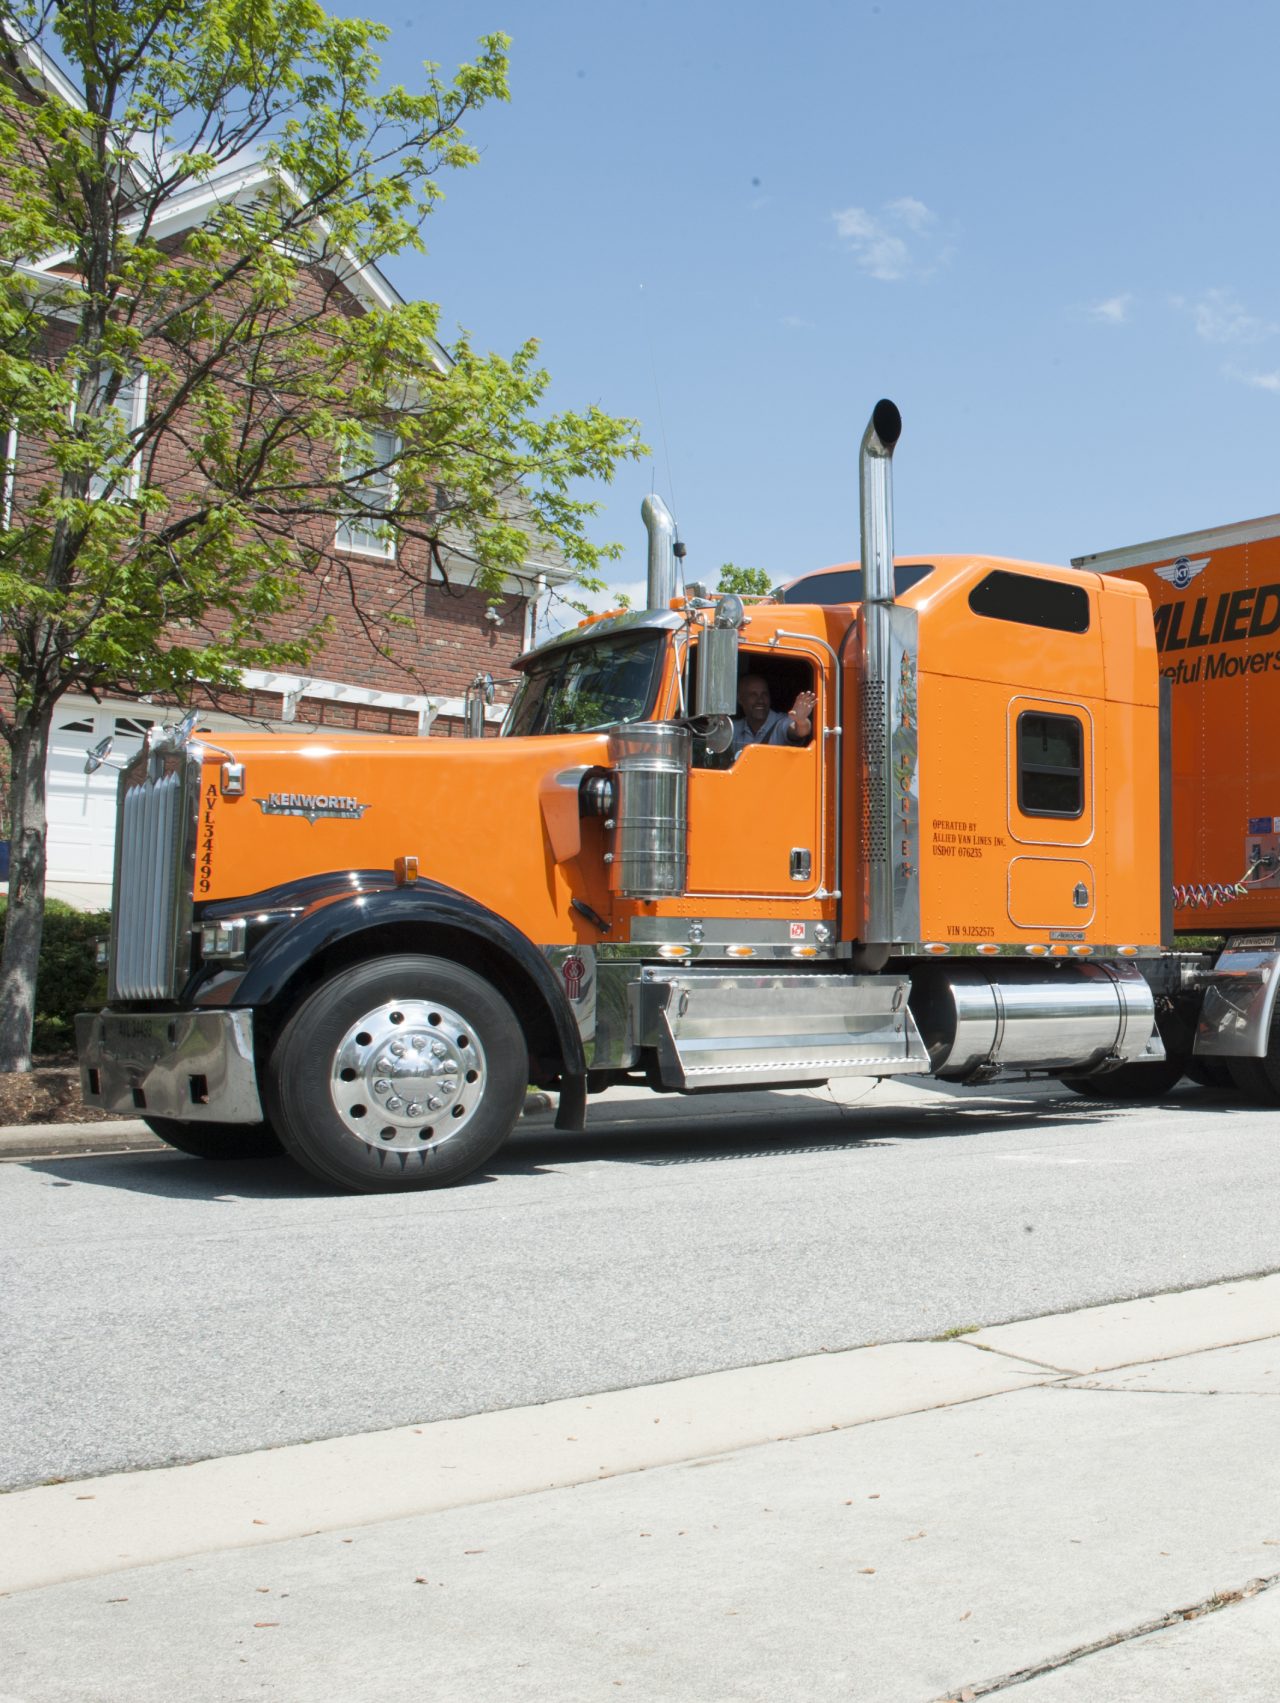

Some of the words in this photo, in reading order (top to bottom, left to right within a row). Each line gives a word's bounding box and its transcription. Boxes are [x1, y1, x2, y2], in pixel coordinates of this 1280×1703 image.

[270, 793, 357, 809] KENWORTH
[933, 820, 967, 831] OPERATED
[199, 784, 217, 893] AVL34499
[933, 832, 956, 843] ALLIED
[957, 834, 971, 844] VAN
[973, 835, 992, 846] LINES
[933, 845, 956, 856] USDOT
[947, 926, 960, 936] VIN
